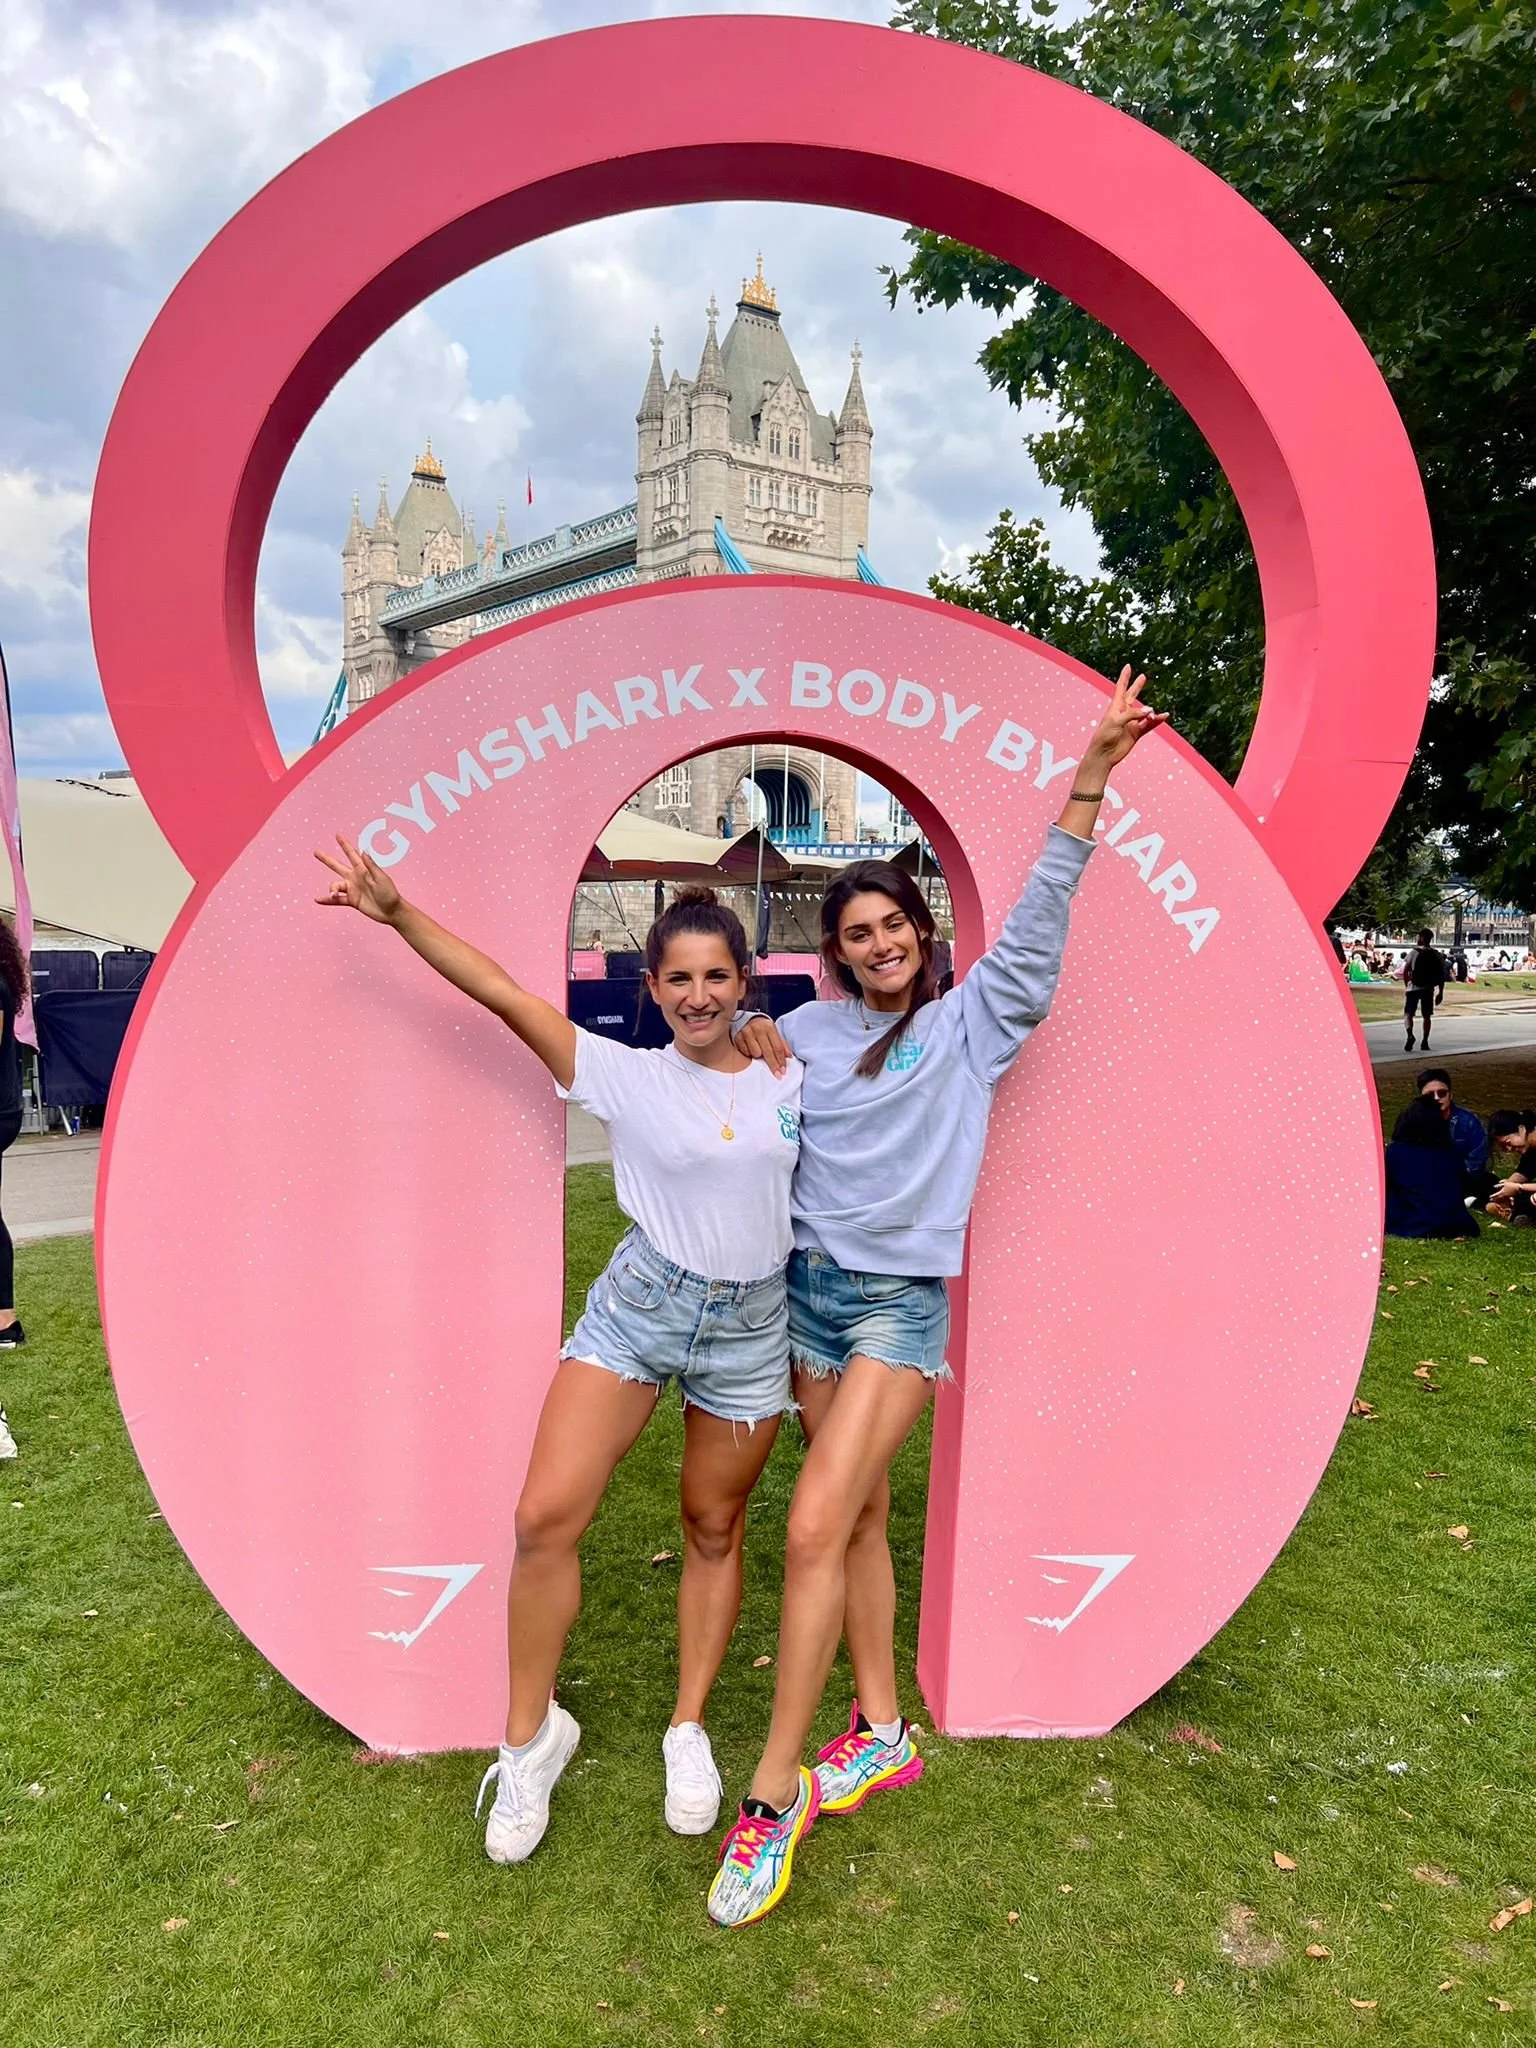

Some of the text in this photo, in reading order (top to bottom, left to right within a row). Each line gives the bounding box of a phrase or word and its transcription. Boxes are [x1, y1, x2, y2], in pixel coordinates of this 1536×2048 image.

[358, 664, 713, 868] GYMSHARK
[790, 661, 983, 743] BODY
[985, 719, 1078, 791] BY
